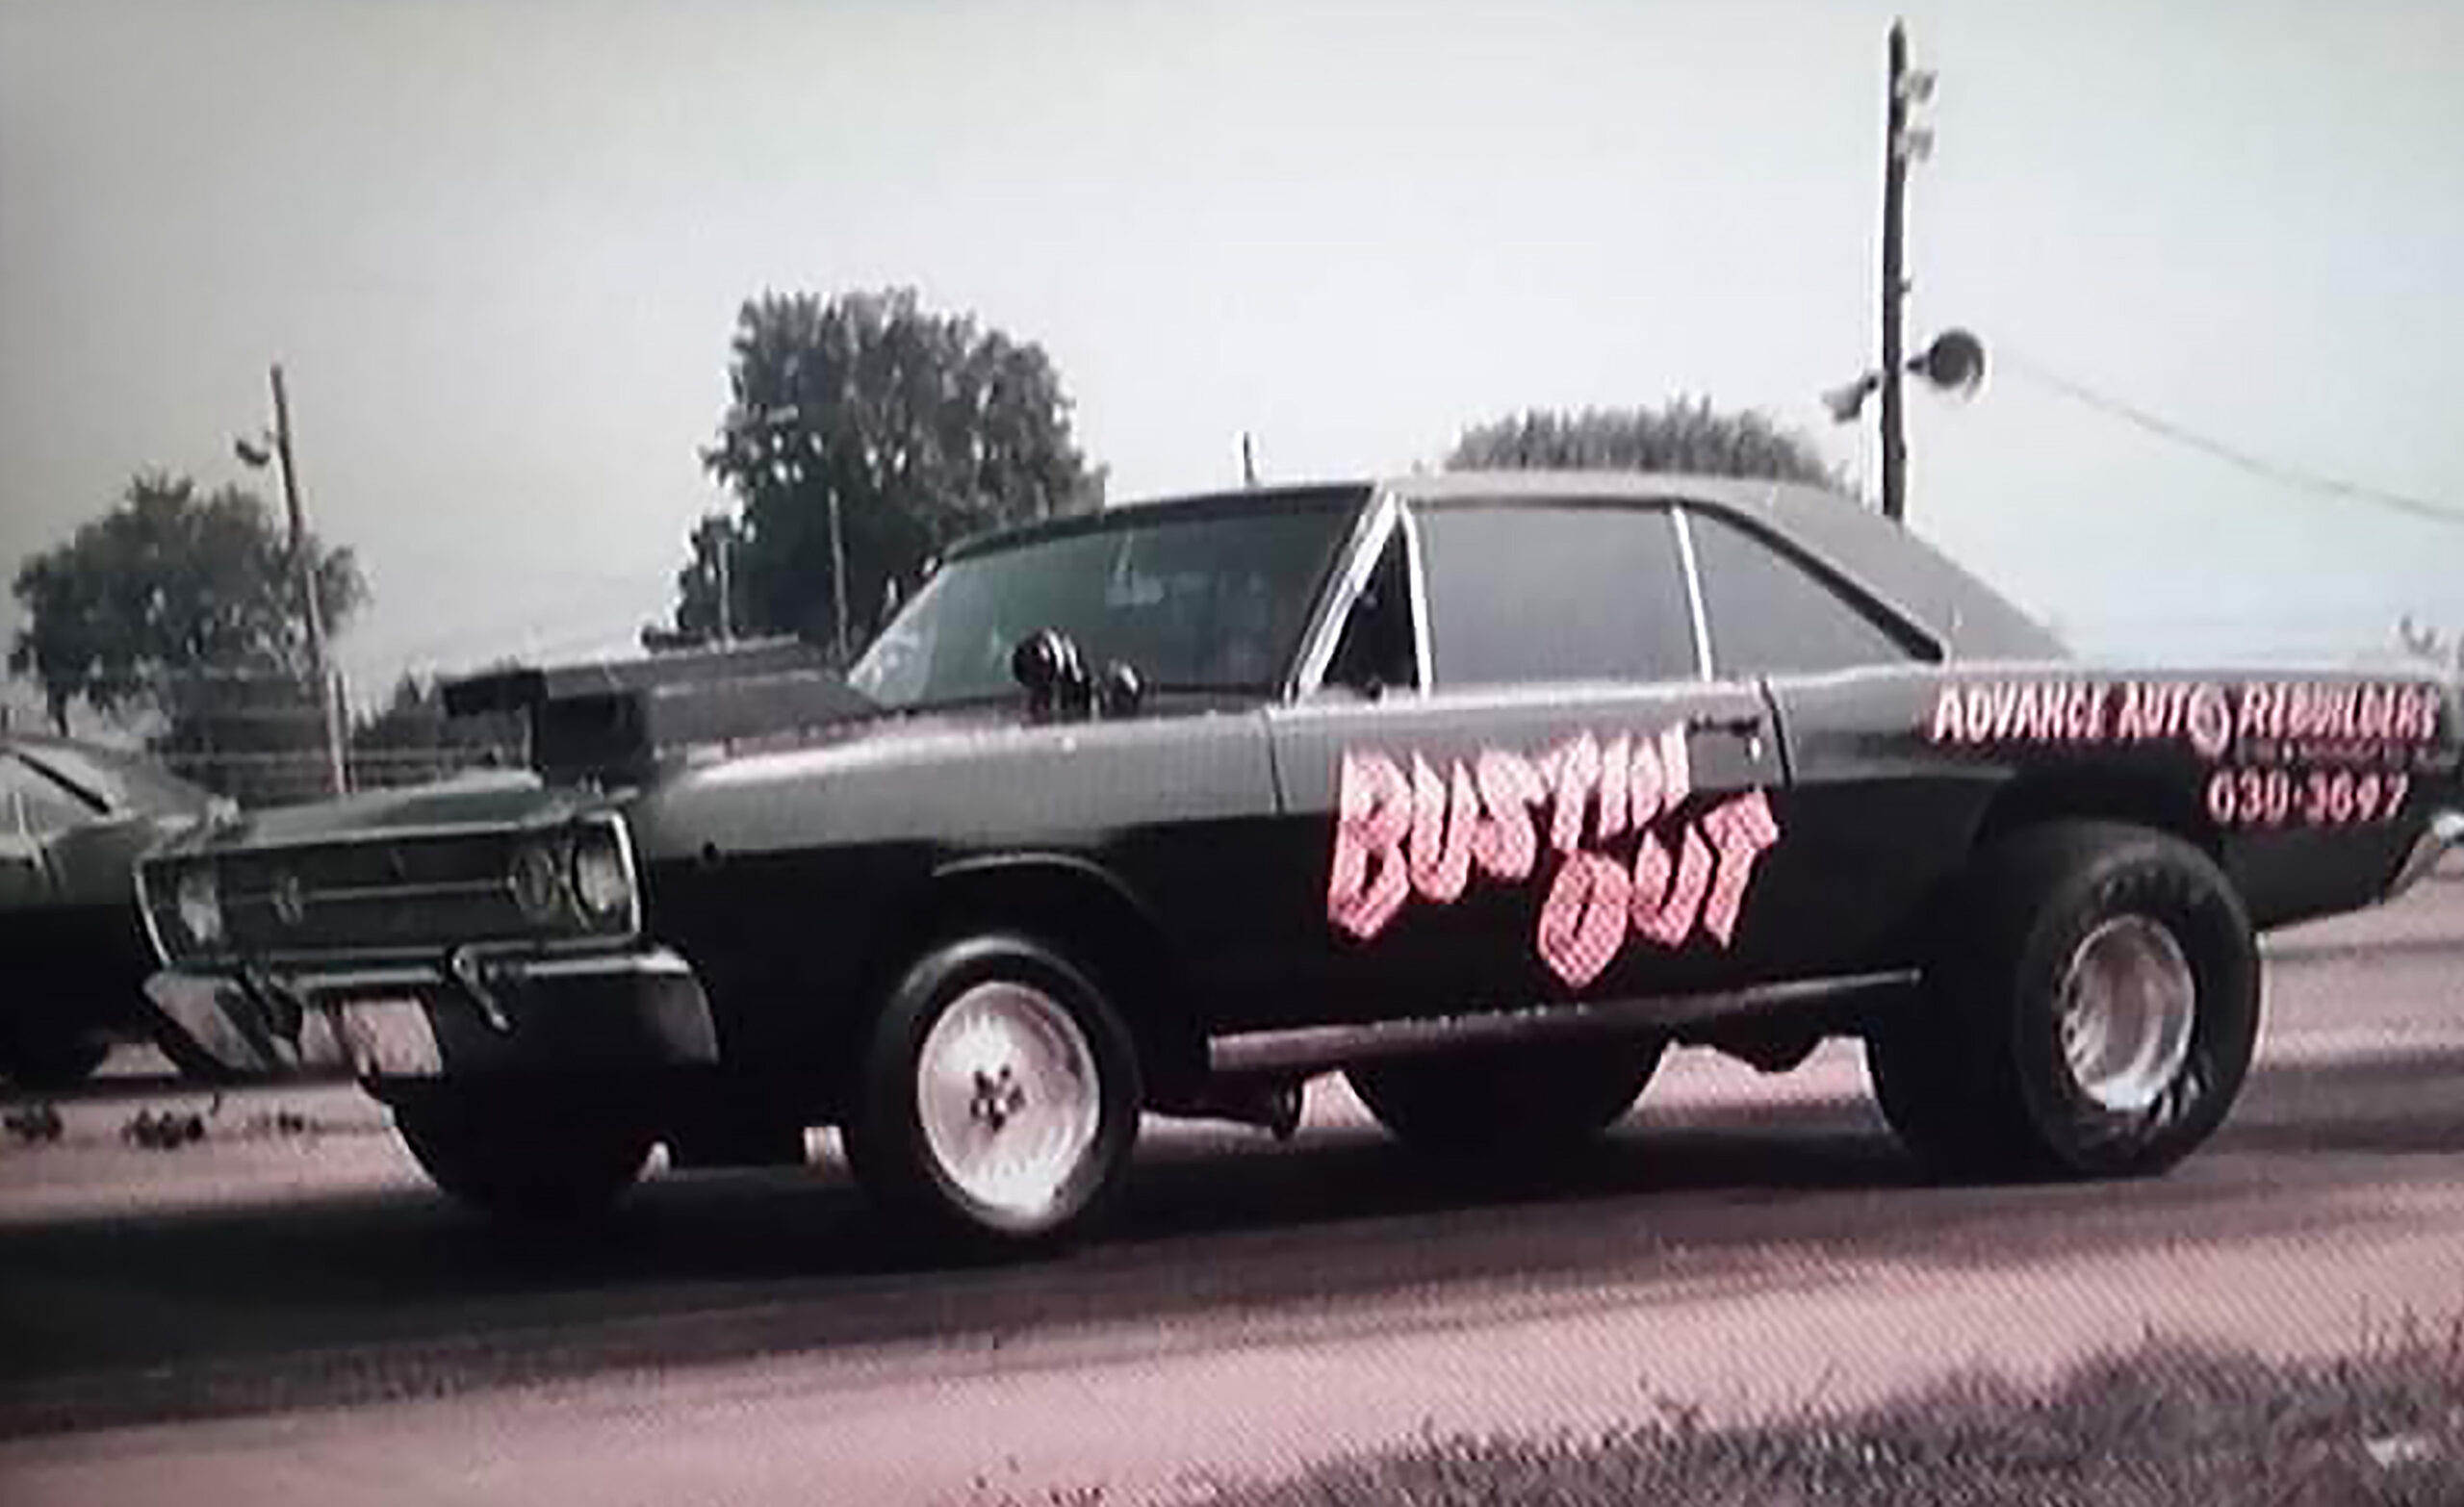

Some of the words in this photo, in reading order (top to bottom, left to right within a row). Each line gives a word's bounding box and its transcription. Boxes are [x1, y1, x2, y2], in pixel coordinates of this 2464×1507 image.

[1933, 680, 2109, 742] ADVANCE
[2118, 680, 2230, 756] AUTO
[1538, 791, 1780, 988] OUT
